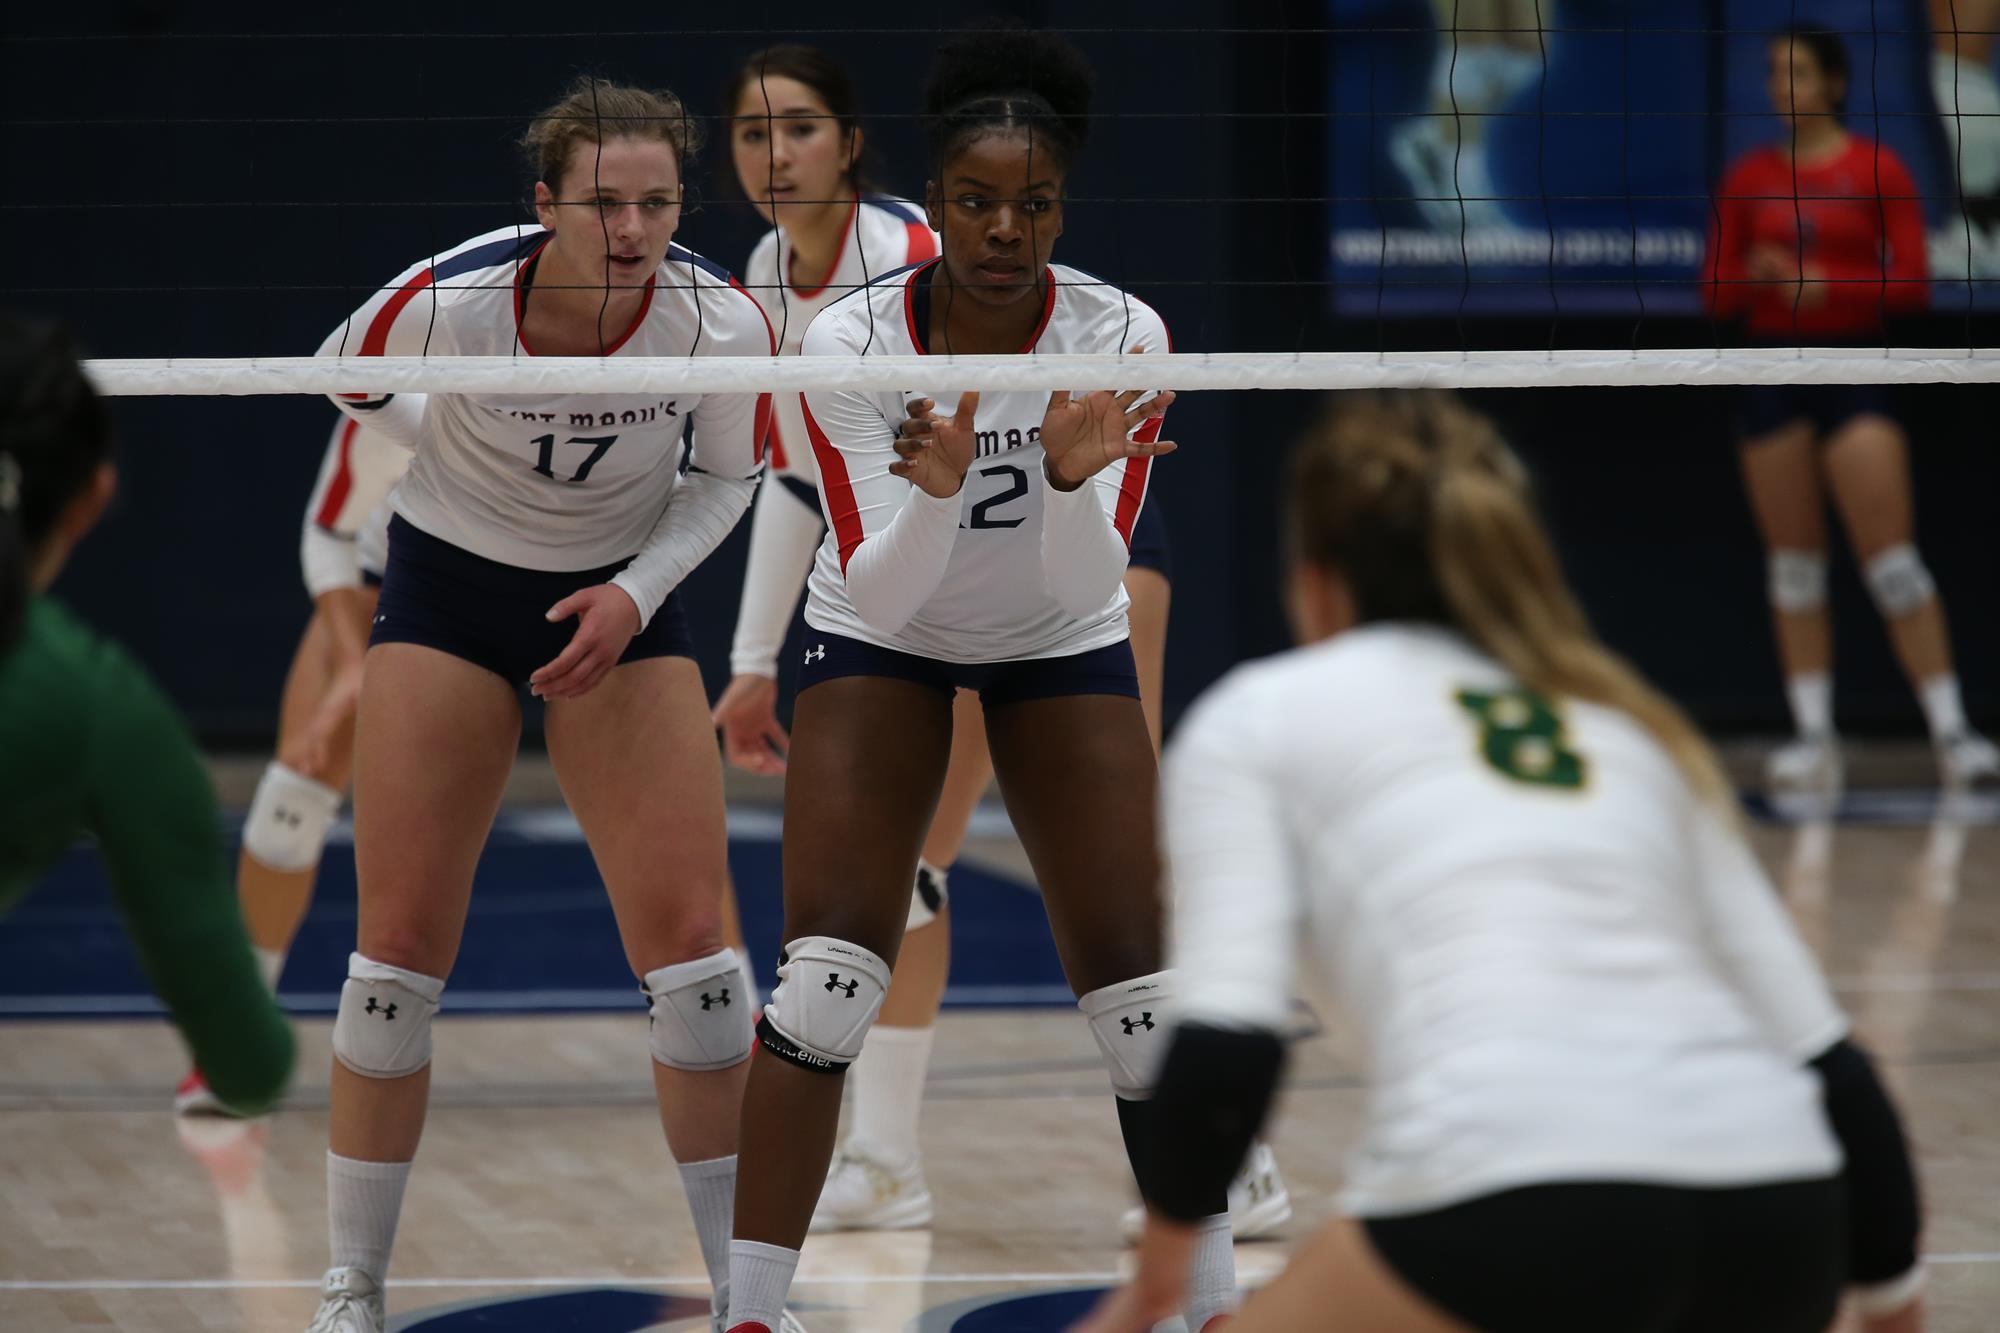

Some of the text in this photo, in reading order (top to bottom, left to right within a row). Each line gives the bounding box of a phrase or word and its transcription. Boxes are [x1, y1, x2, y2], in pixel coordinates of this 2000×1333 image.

[530, 433, 619, 482] 17
[959, 465, 1028, 529] 2
[1450, 685, 1590, 797] 8
